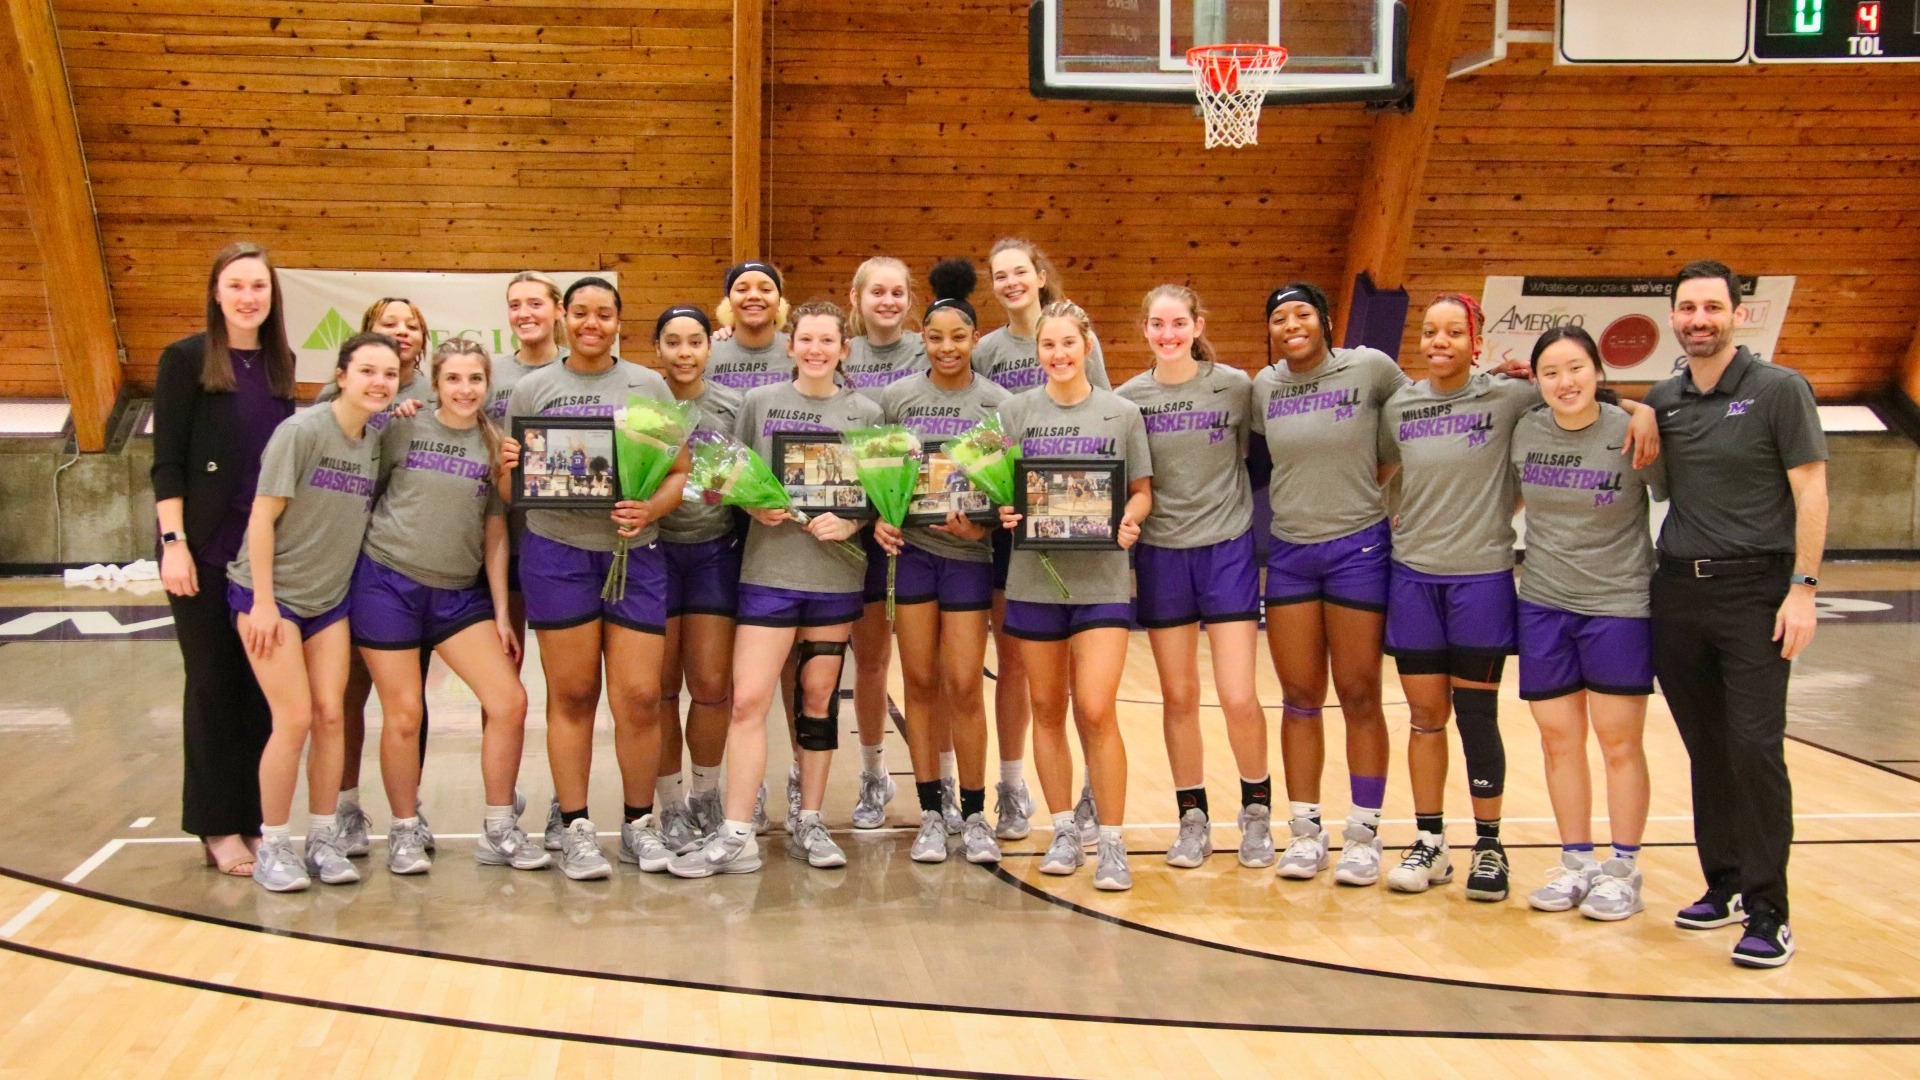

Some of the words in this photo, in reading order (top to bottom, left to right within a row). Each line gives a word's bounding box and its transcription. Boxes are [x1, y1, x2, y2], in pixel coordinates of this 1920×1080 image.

[1858, 4, 1878, 31] 4
[1847, 36, 1884, 56] TOL
[1530, 281, 1579, 293] Whatever
[1580, 284, 1599, 294] you
[1600, 284, 1628, 293] crave
[1632, 281, 1664, 293] we've
[714, 362, 768, 374] MILLSAPS
[845, 362, 893, 374] MILLSAPS
[992, 357, 1040, 375] MILLSAPS
[1270, 381, 1319, 400] MILLSAPS
[541, 395, 601, 411] MILLSAPS
[907, 406, 961, 418] MILLSAPS
[1140, 400, 1194, 416] MILLSAPS
[1266, 387, 1361, 421] BASKETBALL
[766, 408, 822, 424] MILLSAPS
[1402, 404, 1453, 422] MILLSAPS
[1026, 426, 1080, 438] MILLSAPS
[1399, 412, 1494, 442] BASKETBALL
[1468, 429, 1487, 447] M
[409, 440, 467, 458] MILLSAPS
[1023, 437, 1116, 458] BASKETBALL
[319, 456, 362, 475] MILLSAPS
[1526, 452, 1583, 468] MILLSAPS
[1522, 463, 1623, 491] BASKETBALL
[1594, 490, 1614, 507] M
